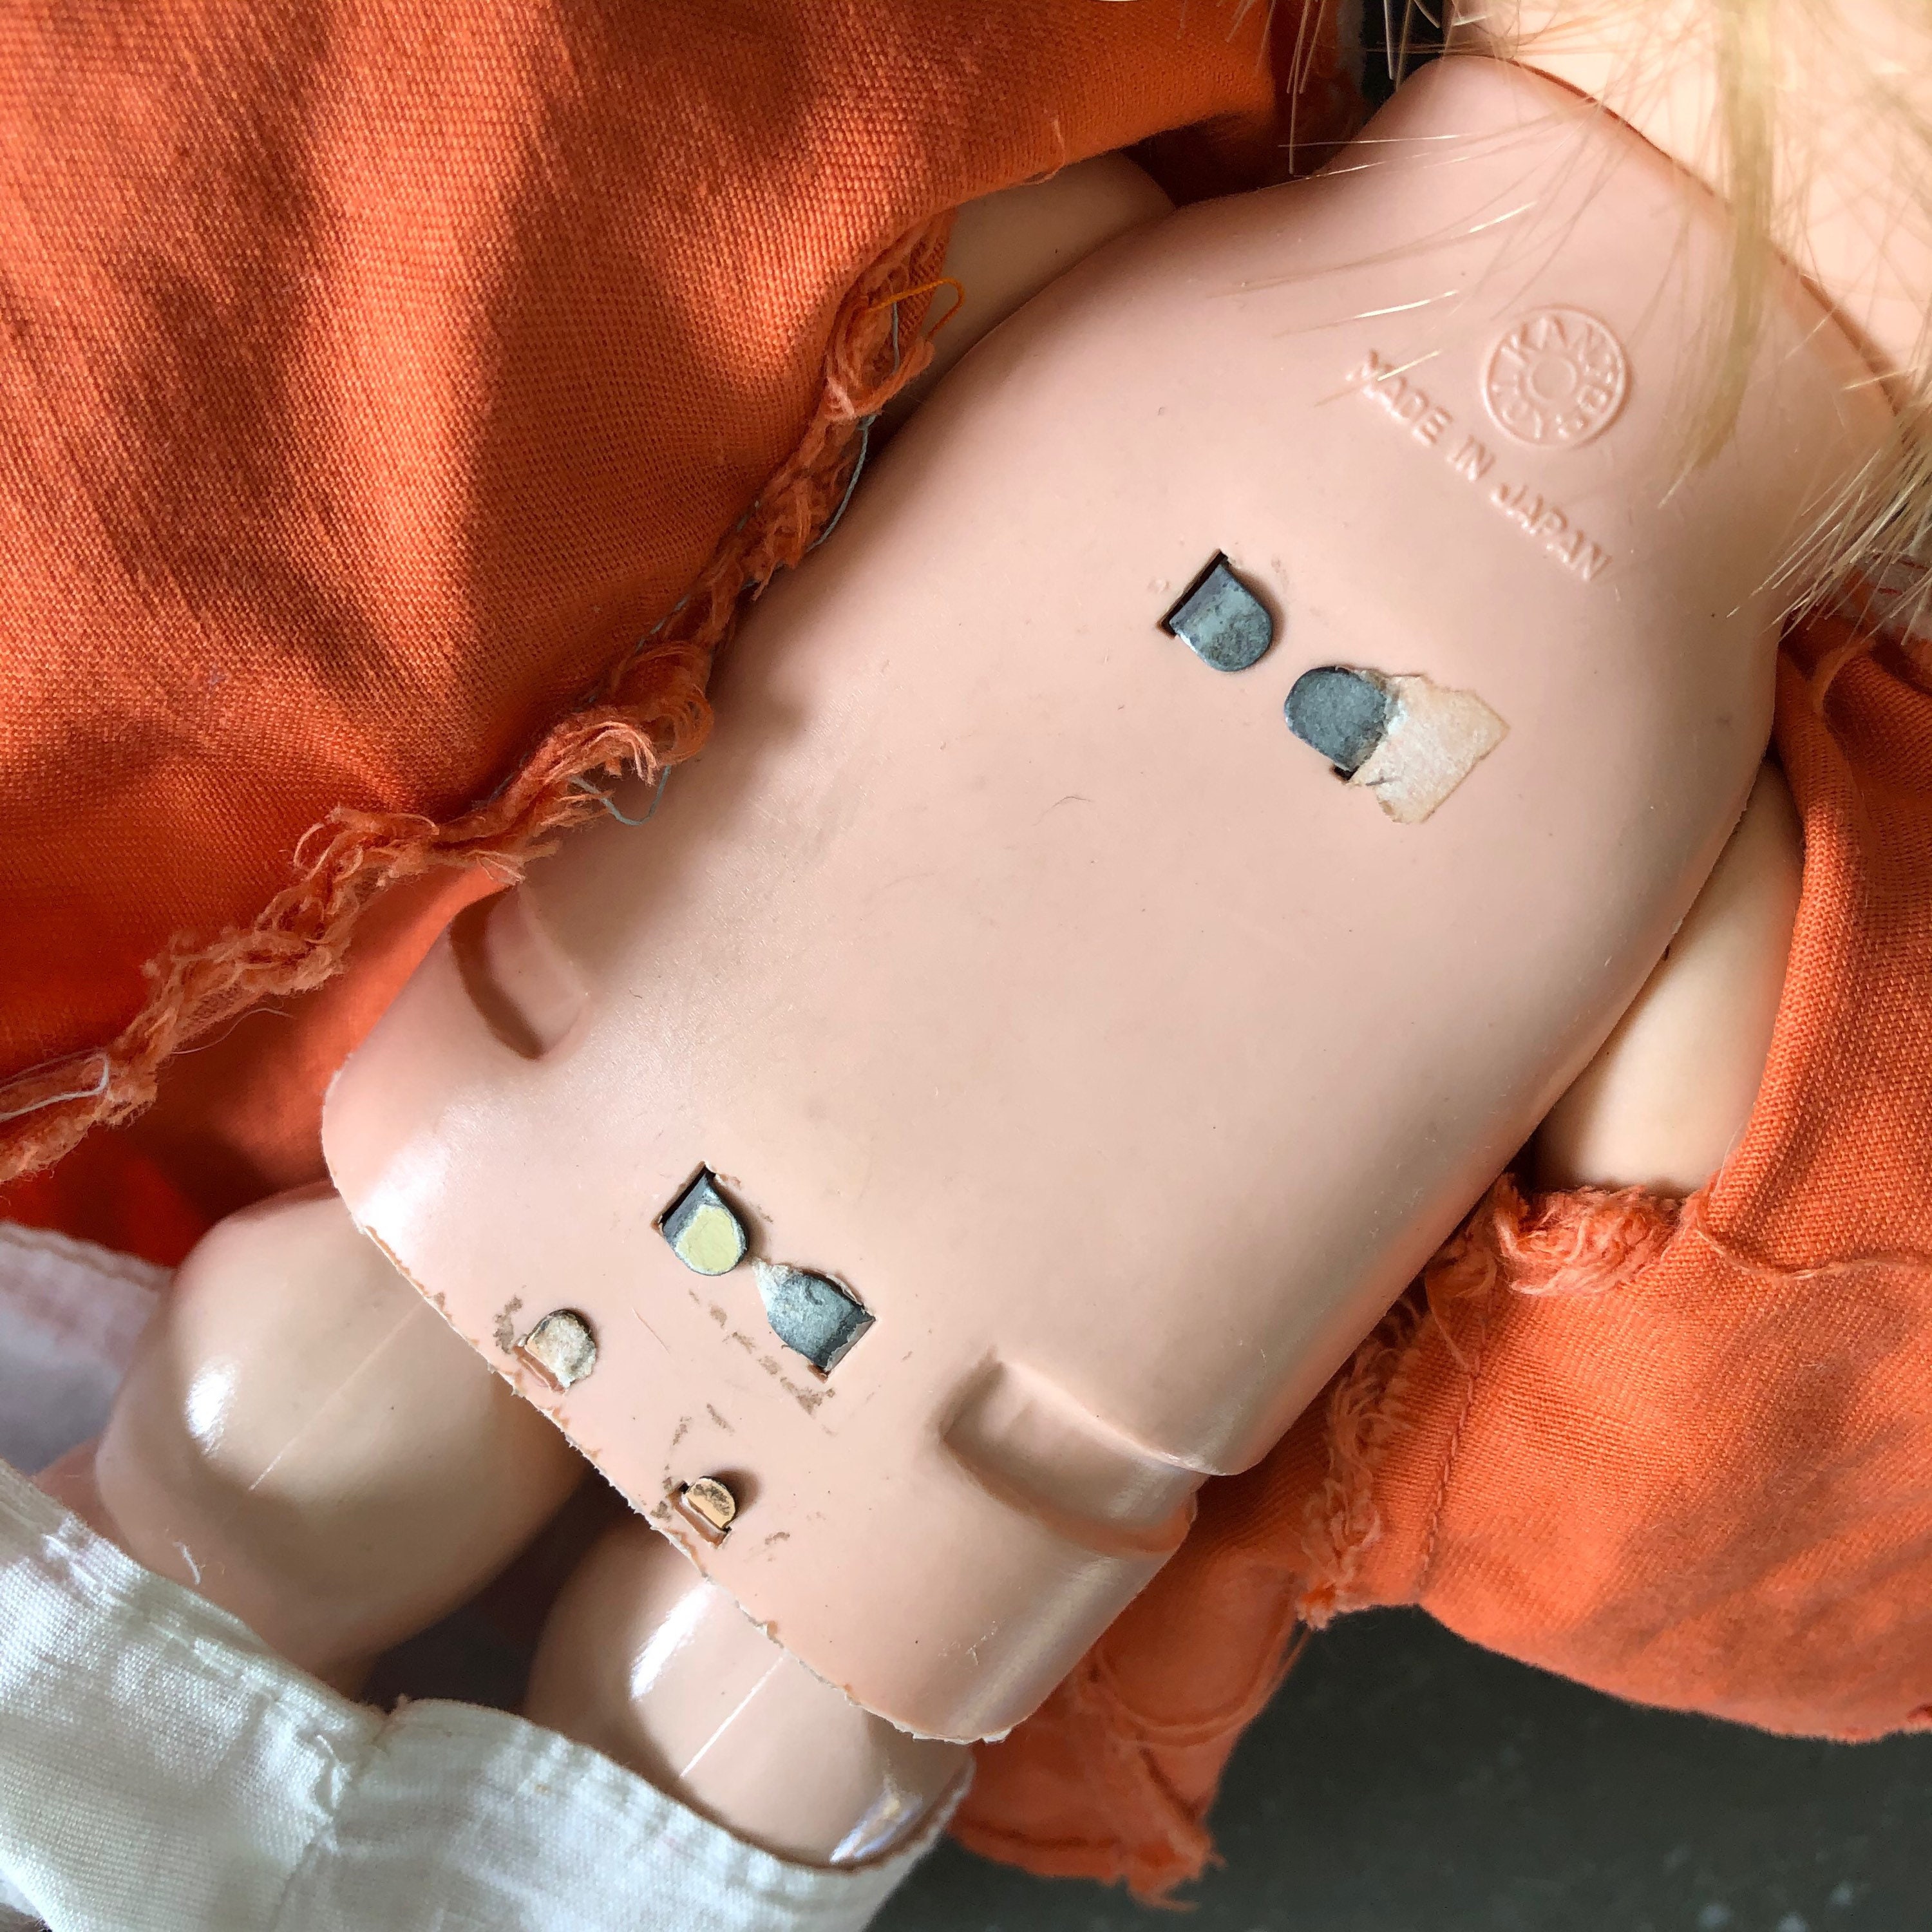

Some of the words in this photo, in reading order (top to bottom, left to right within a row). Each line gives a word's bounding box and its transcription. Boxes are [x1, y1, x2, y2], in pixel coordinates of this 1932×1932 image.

[1347, 348, 1454, 446] MADE
[1445, 435, 1496, 482] IN
[1489, 483, 1613, 582] JAPAN
